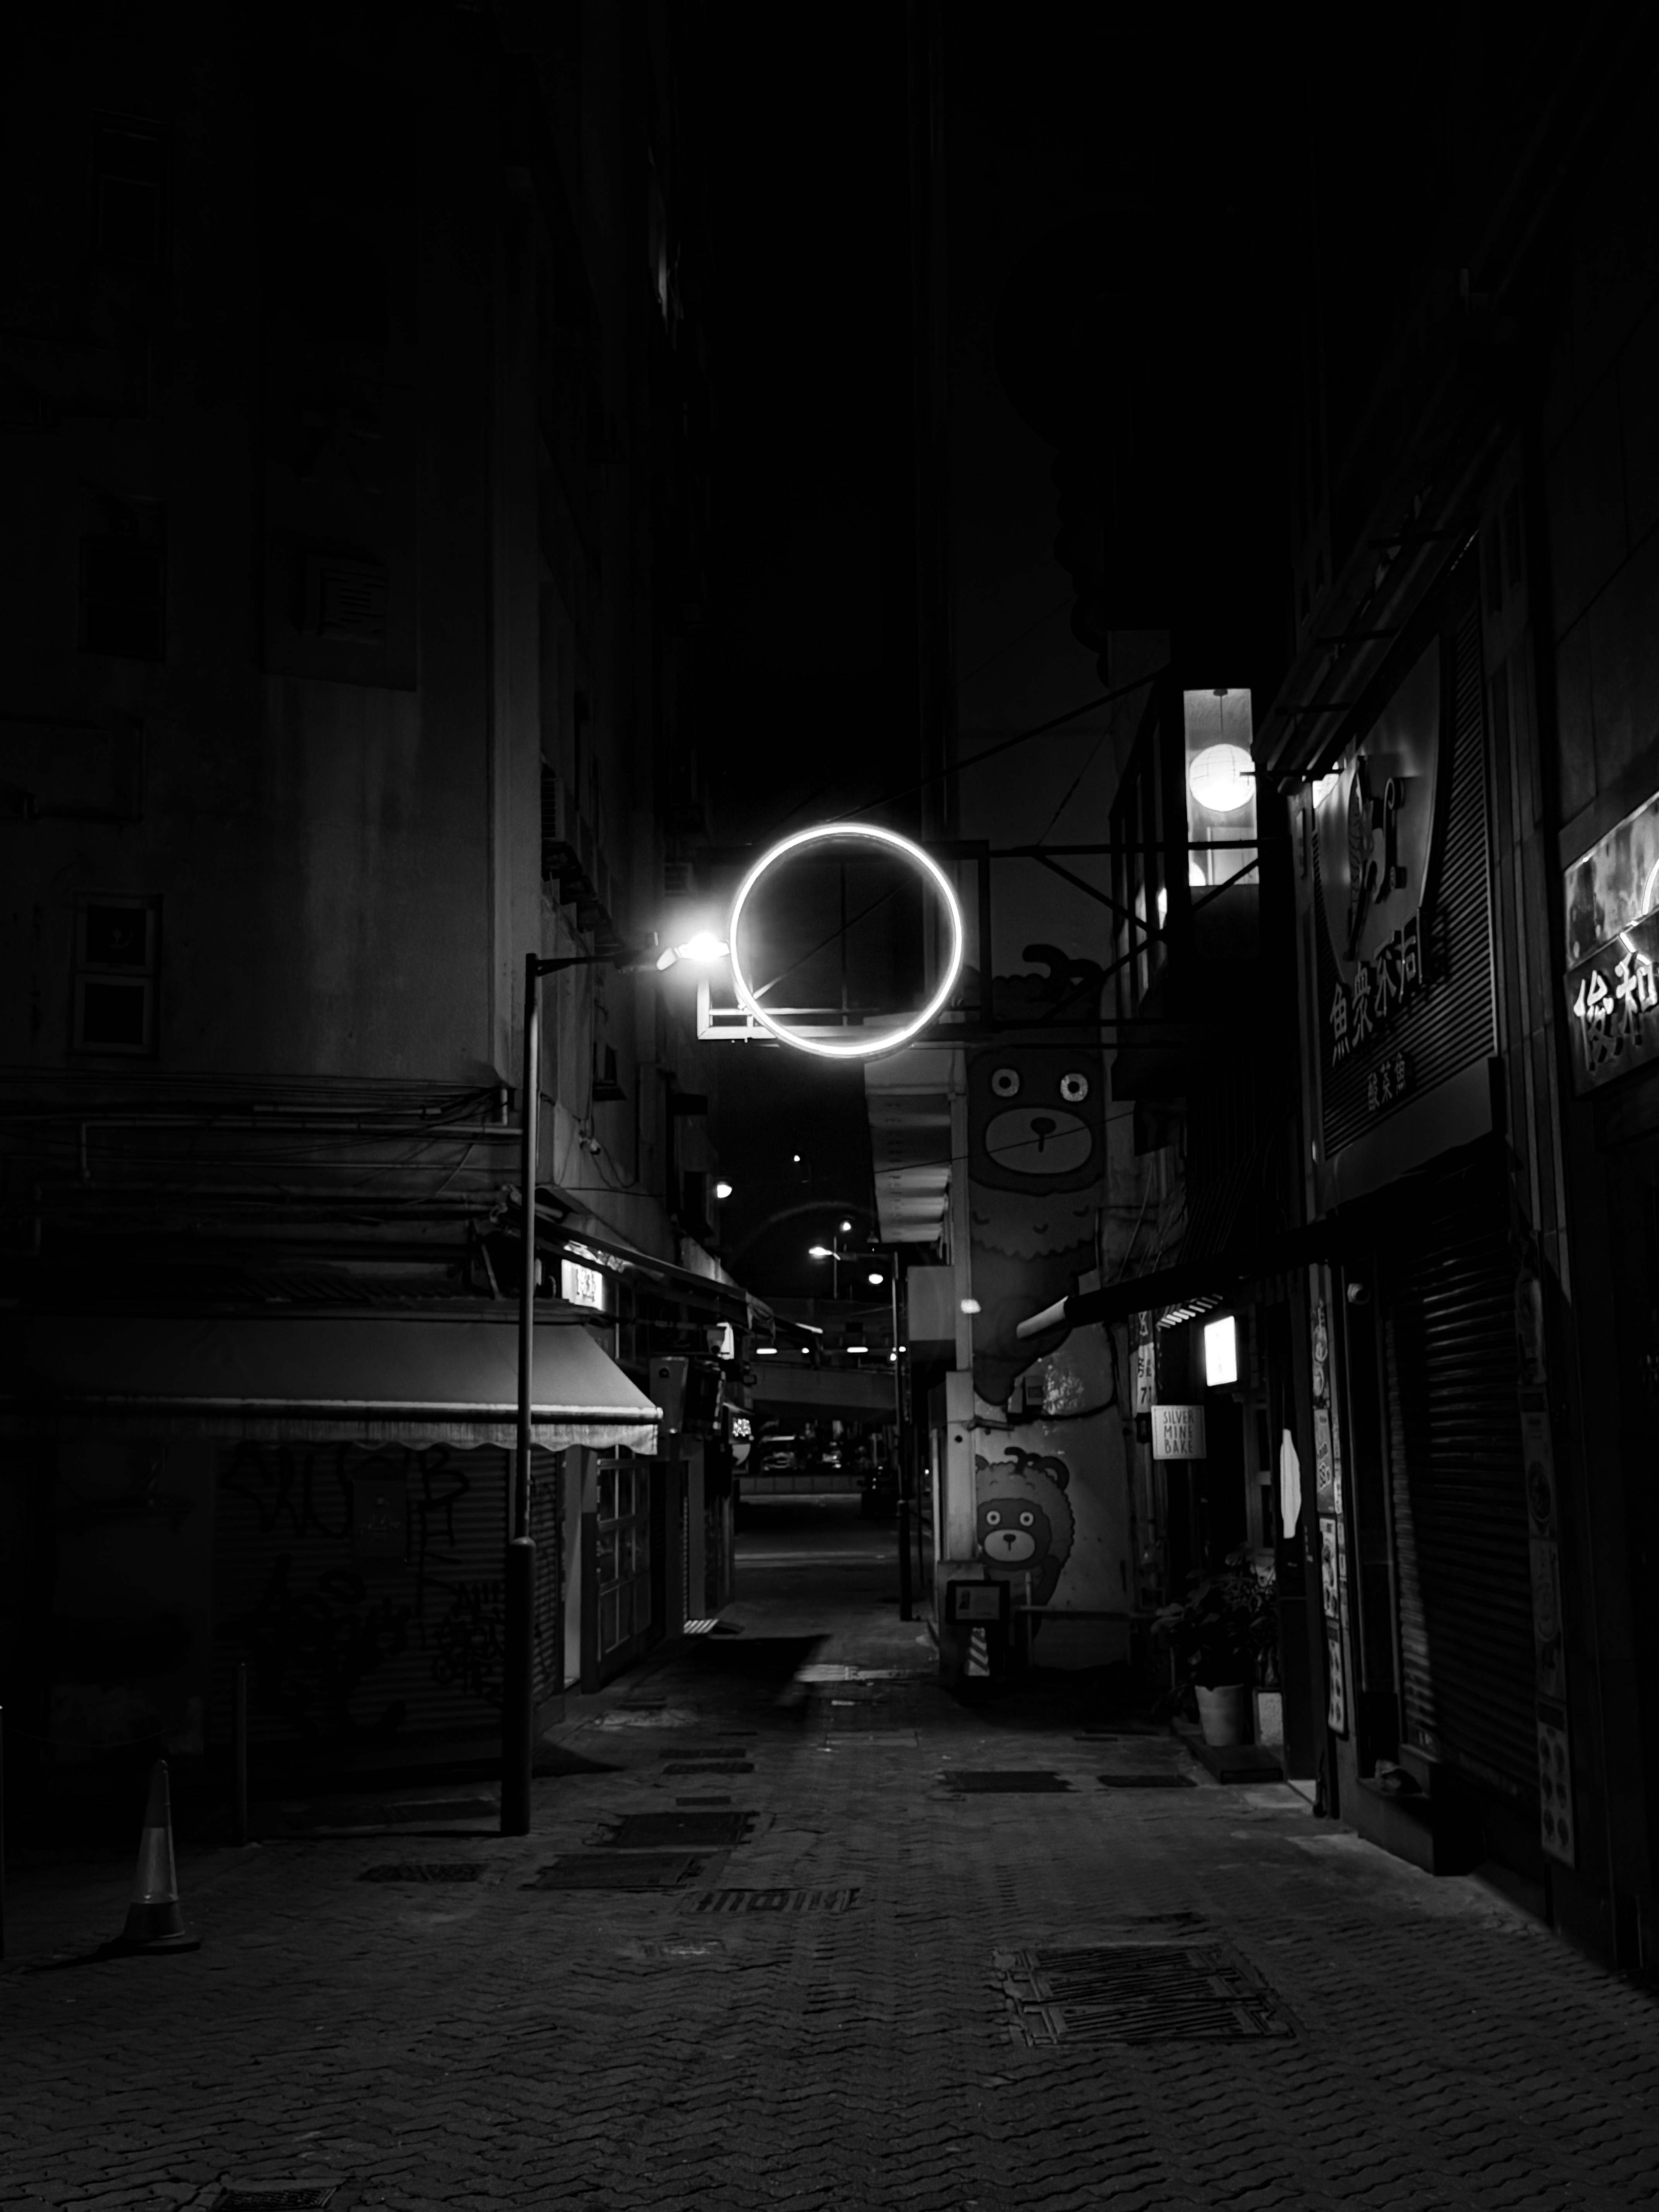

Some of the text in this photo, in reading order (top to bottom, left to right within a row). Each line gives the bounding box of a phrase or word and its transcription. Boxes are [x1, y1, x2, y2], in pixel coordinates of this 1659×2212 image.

[1163, 1410, 1194, 1424] SILVER
[1164, 1425, 1192, 1439] MINE
[1165, 1439, 1192, 1454] BAKE
